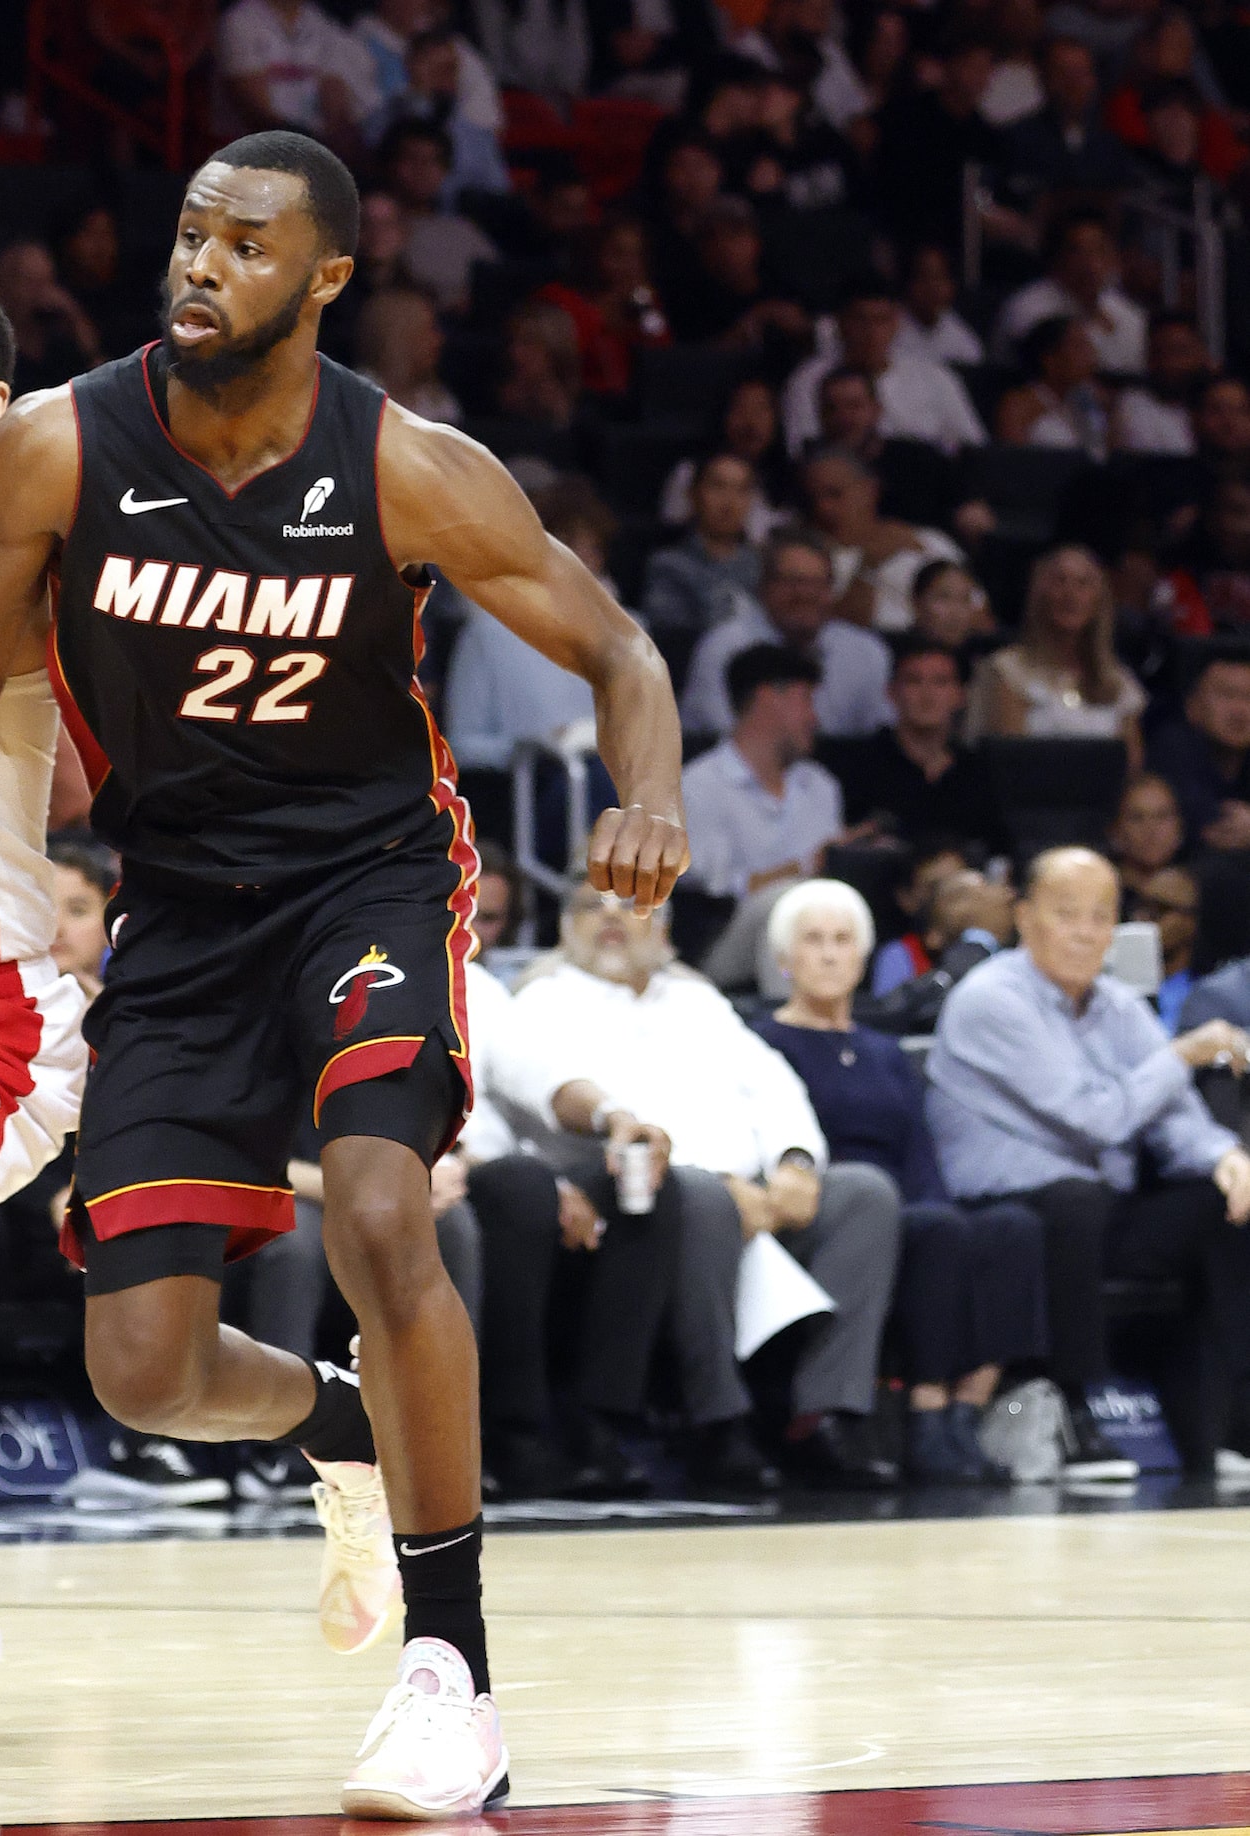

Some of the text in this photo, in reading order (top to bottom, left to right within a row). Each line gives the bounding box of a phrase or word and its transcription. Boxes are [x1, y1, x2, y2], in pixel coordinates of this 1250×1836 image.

[282, 522, 354, 538] Robinhood
[92, 553, 356, 640] MIAMI
[175, 644, 331, 725] 22
